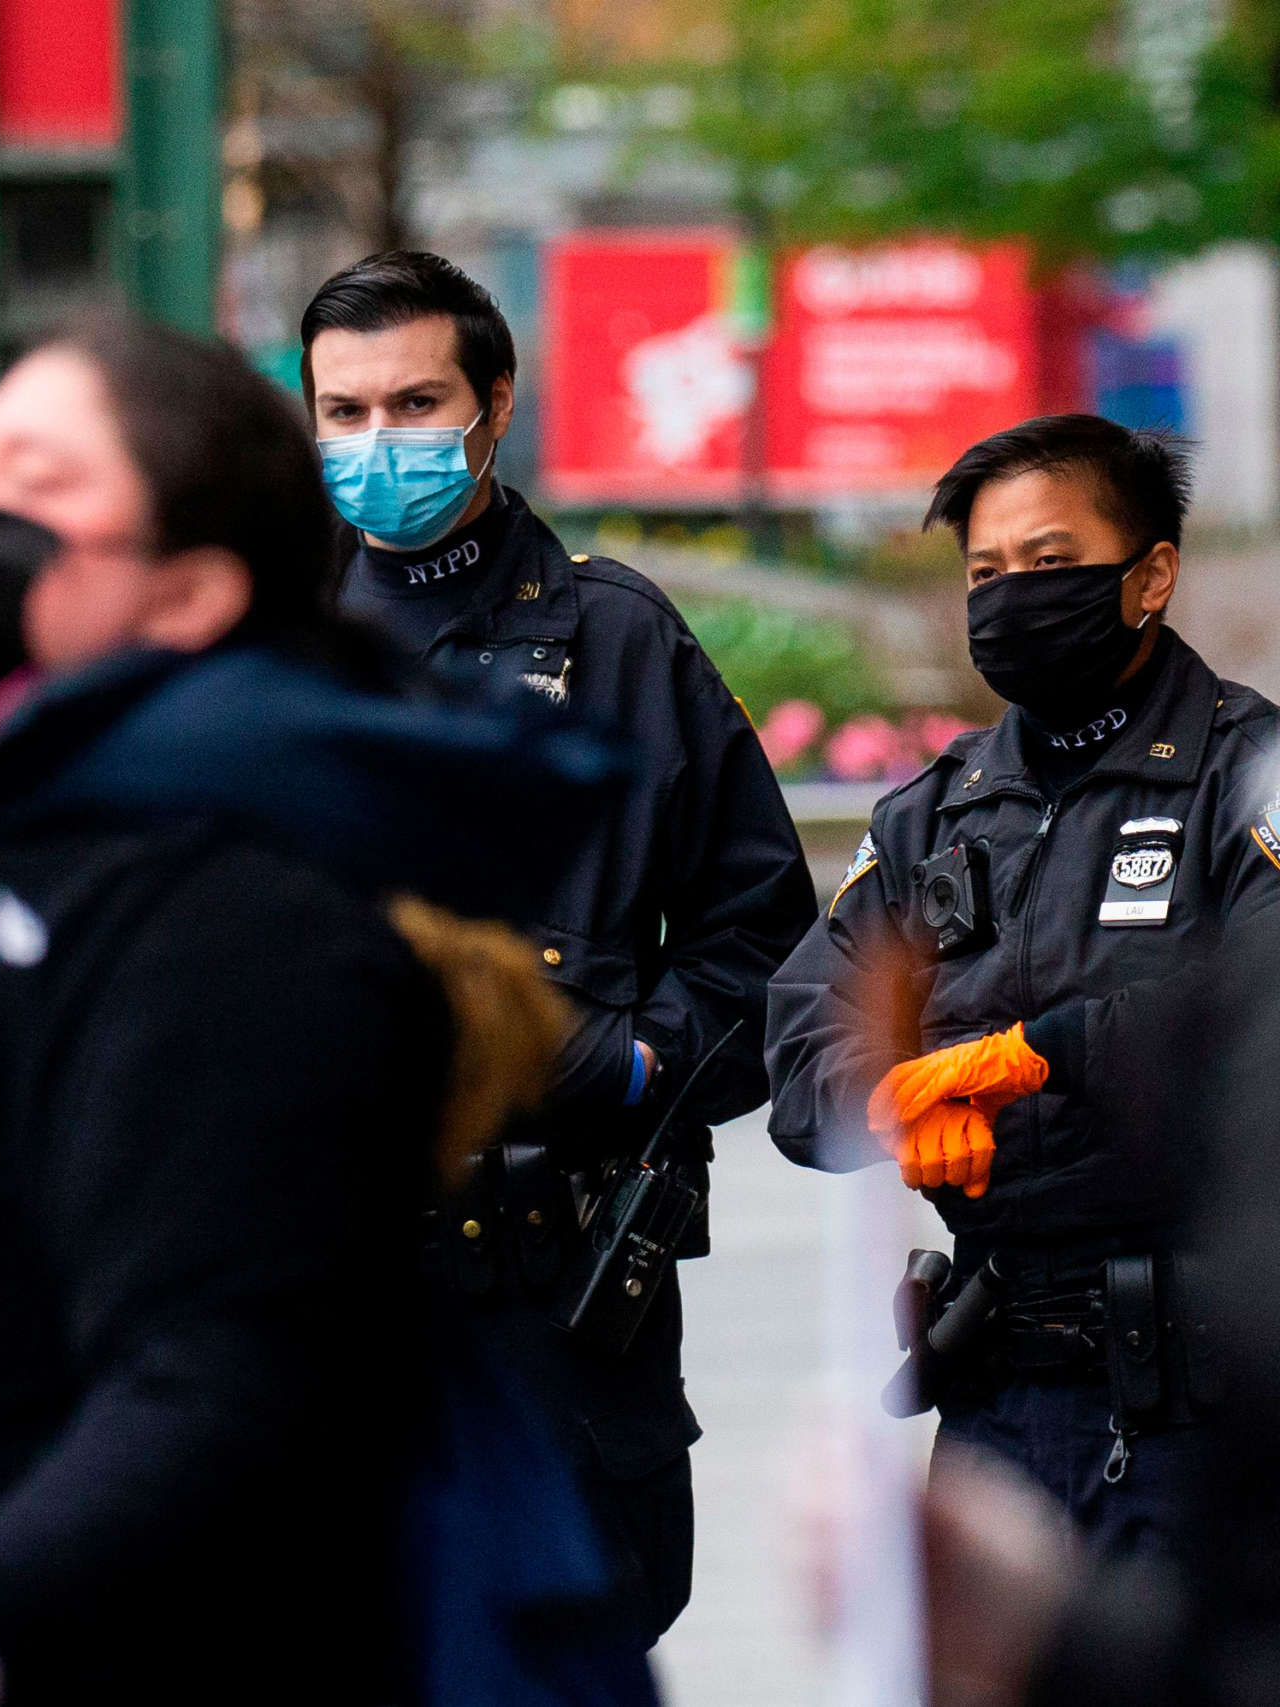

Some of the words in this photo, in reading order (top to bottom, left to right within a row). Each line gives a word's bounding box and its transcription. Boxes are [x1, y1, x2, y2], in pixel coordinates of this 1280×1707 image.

[403, 540, 480, 584] NYPD
[1042, 708, 1127, 750] NYPD
[1119, 857, 1165, 879] 5887
